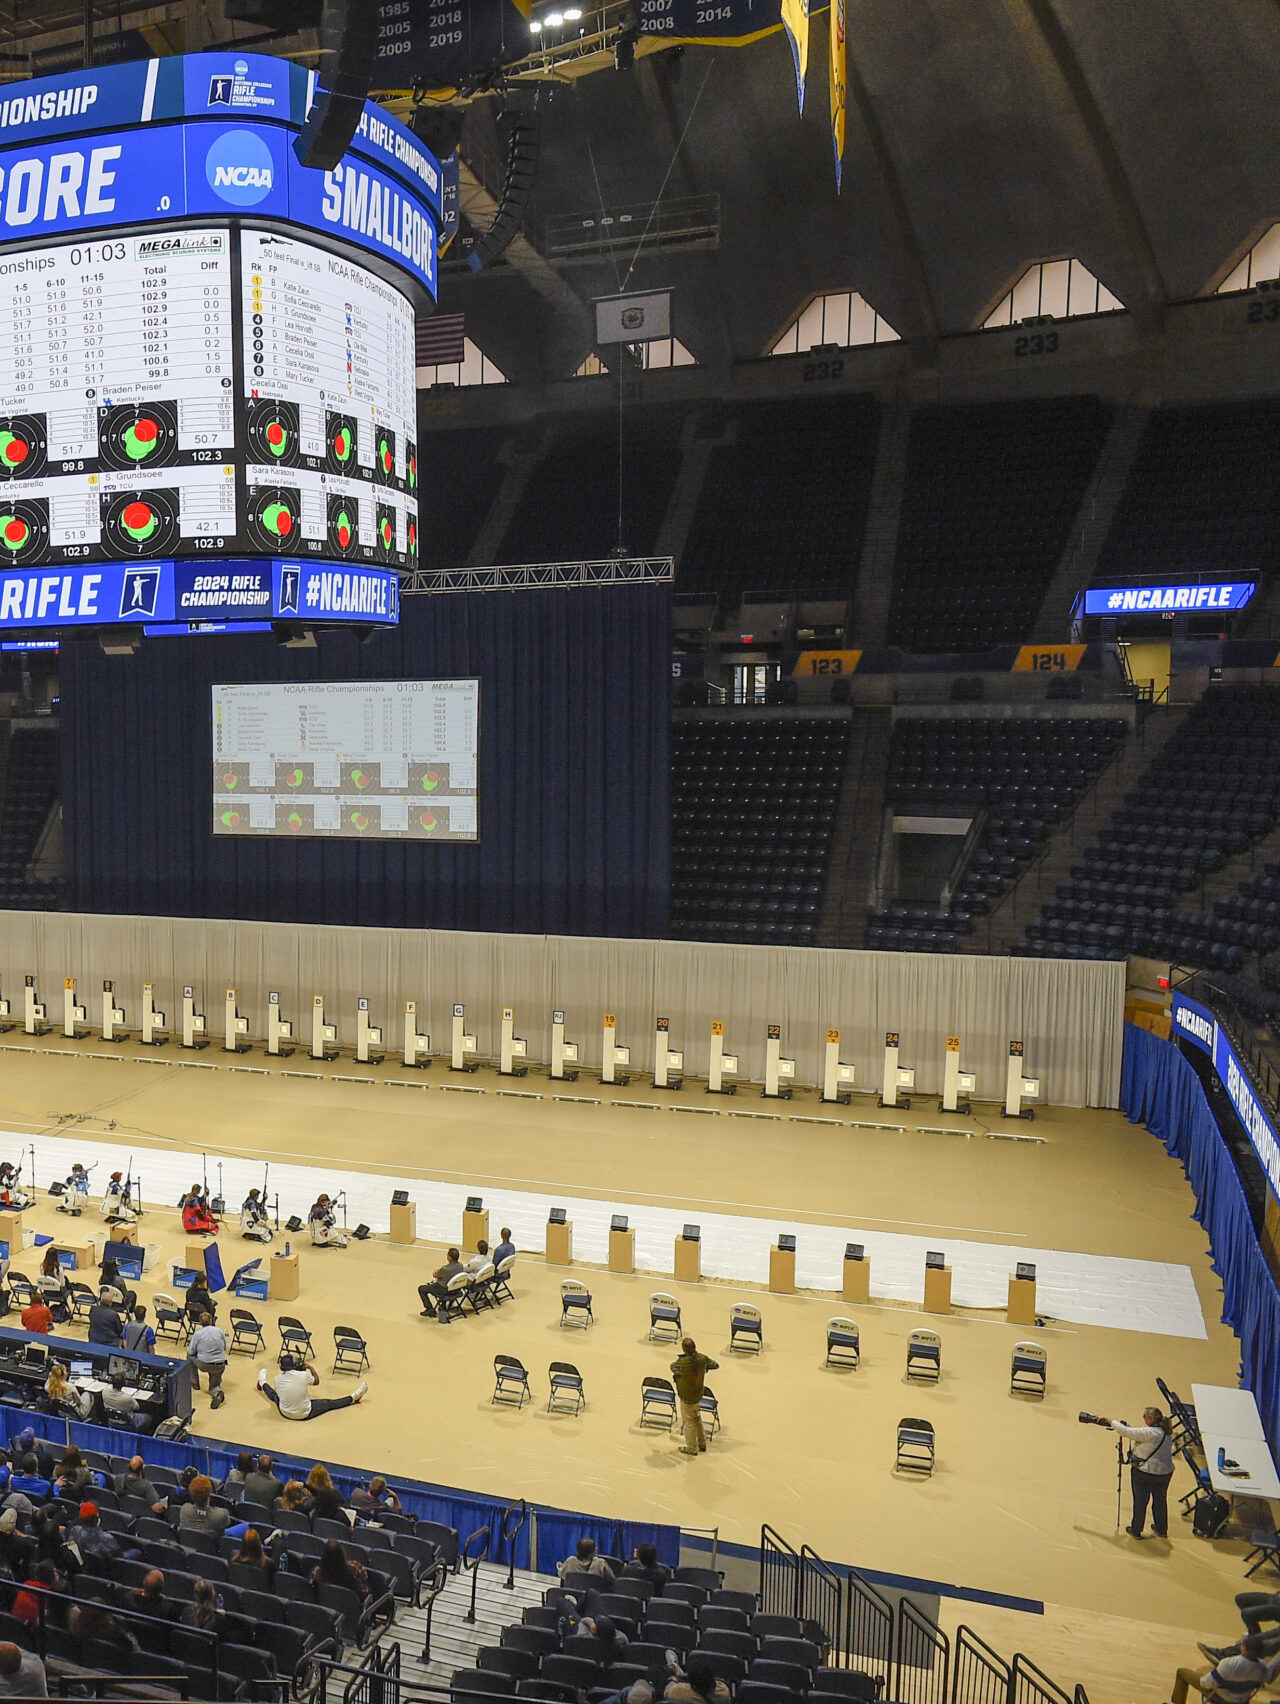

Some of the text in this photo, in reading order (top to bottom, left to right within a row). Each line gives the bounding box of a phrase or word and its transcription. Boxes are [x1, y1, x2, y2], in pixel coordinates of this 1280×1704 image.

[379, 2, 410, 18] 1985
[696, 6, 732, 24] 2014
[429, 10, 462, 28] 2018
[640, 17, 675, 31] 2008
[378, 21, 411, 38] 2005
[429, 30, 462, 47] 2019
[378, 41, 411, 57] 2009
[234, 86, 256, 96] RIFLE
[369, 118, 394, 155] RIFLE
[395, 136, 439, 195] CHAMPIONSHIP
[213, 166, 273, 189] NCAA
[322, 163, 434, 282] SMALLBORE
[70, 243, 126, 266] 01:03
[15, 261, 219, 292] 1-5 6-10 11-15 Total Diff
[328, 260, 398, 307] NCAA Rifle Championships
[82, 287, 102, 296] 50.6
[141, 279, 167, 288] 102.9
[83, 299, 103, 308] 51.9
[142, 292, 167, 301] 102.9
[203, 288, 218, 296] 0.0
[83, 312, 102, 321] 42.1
[142, 305, 167, 314] 102.9
[204, 301, 219, 309] 0.0
[83, 324, 103, 333] 52.0
[142, 318, 167, 327] 102.4
[204, 314, 219, 322] 0.5
[84, 337, 103, 346] 50.7
[143, 331, 168, 340] 102.3
[205, 327, 219, 335] 0.1
[1015, 332, 1059, 357] 233
[85, 350, 104, 359] 41.0
[143, 344, 168, 352] 102.1
[205, 340, 220, 348] 0.2
[85, 363, 104, 372] 51.1
[143, 357, 169, 366] 100.6
[206, 353, 220, 361] 1.5
[803, 360, 844, 382] 232
[85, 375, 104, 384] 51.7
[148, 369, 169, 378] 99.8
[205, 365, 220, 374] 0.8
[102, 383, 162, 395] Braden Peiser
[250, 378, 288, 390] Cecelia Ossi
[191, 451, 222, 461] 102.3
[62, 462, 84, 471] 99.8
[252, 466, 295, 477] Sara Karasova
[116, 470, 163, 481] Grundsoee
[4, 480, 44, 490] Ceccarello
[193, 539, 224, 549] 102.9
[193, 575, 261, 591] 2024 RIFLE
[180, 591, 270, 607] CHAMPIONSHIP
[305, 572, 387, 615] #NCAARIFLE
[1108, 586, 1232, 610] #NCAARIFLE
[811, 658, 842, 676] 123
[1032, 653, 1066, 671] 124
[284, 683, 424, 695] NCAA Rifle Championships 01:03
[605, 1015, 615, 1023] 19
[712, 1022, 722, 1030] 21
[828, 1030, 839, 1038] 23
[887, 1034, 898, 1042] 24
[948, 1038, 959, 1046] 25
[1011, 1042, 1022, 1050] 26
